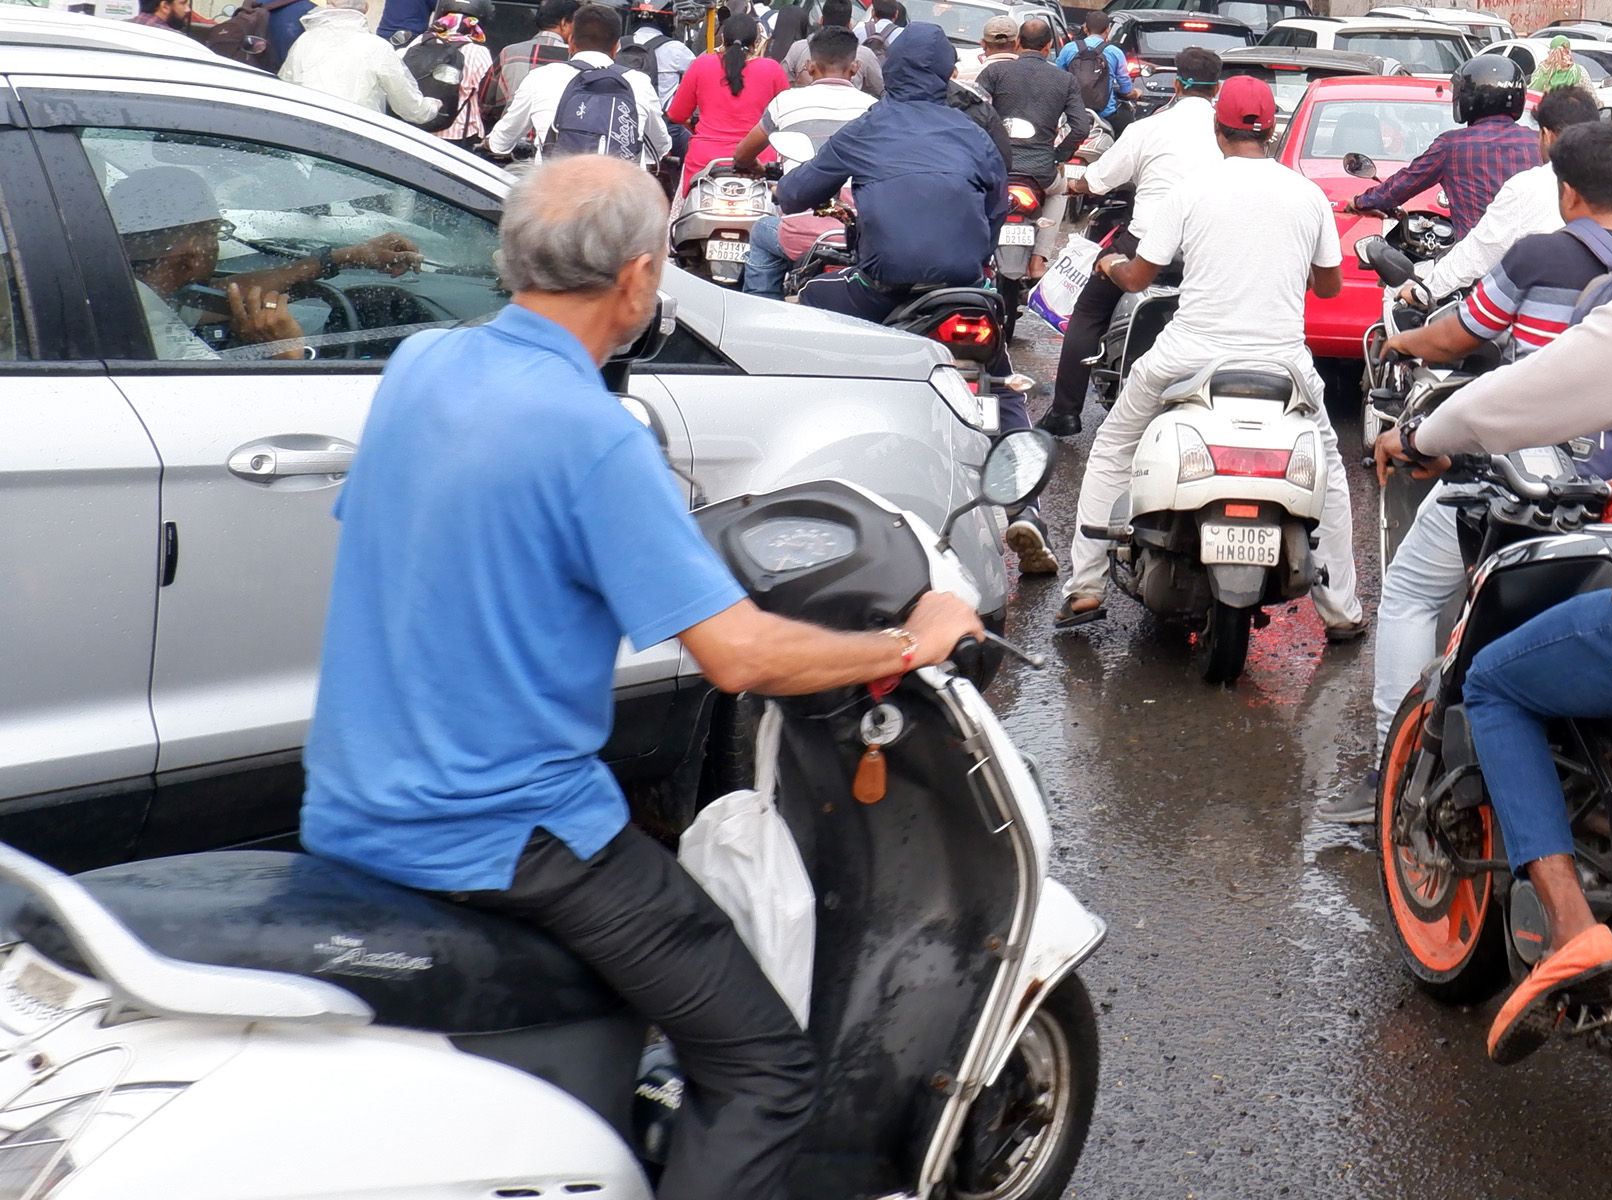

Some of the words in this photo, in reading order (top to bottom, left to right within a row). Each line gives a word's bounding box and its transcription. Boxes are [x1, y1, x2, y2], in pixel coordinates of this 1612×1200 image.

[1005, 235, 1033, 245] D2165
[1227, 527, 1266, 545] GJ06
[1216, 545, 1275, 564] HN8085
